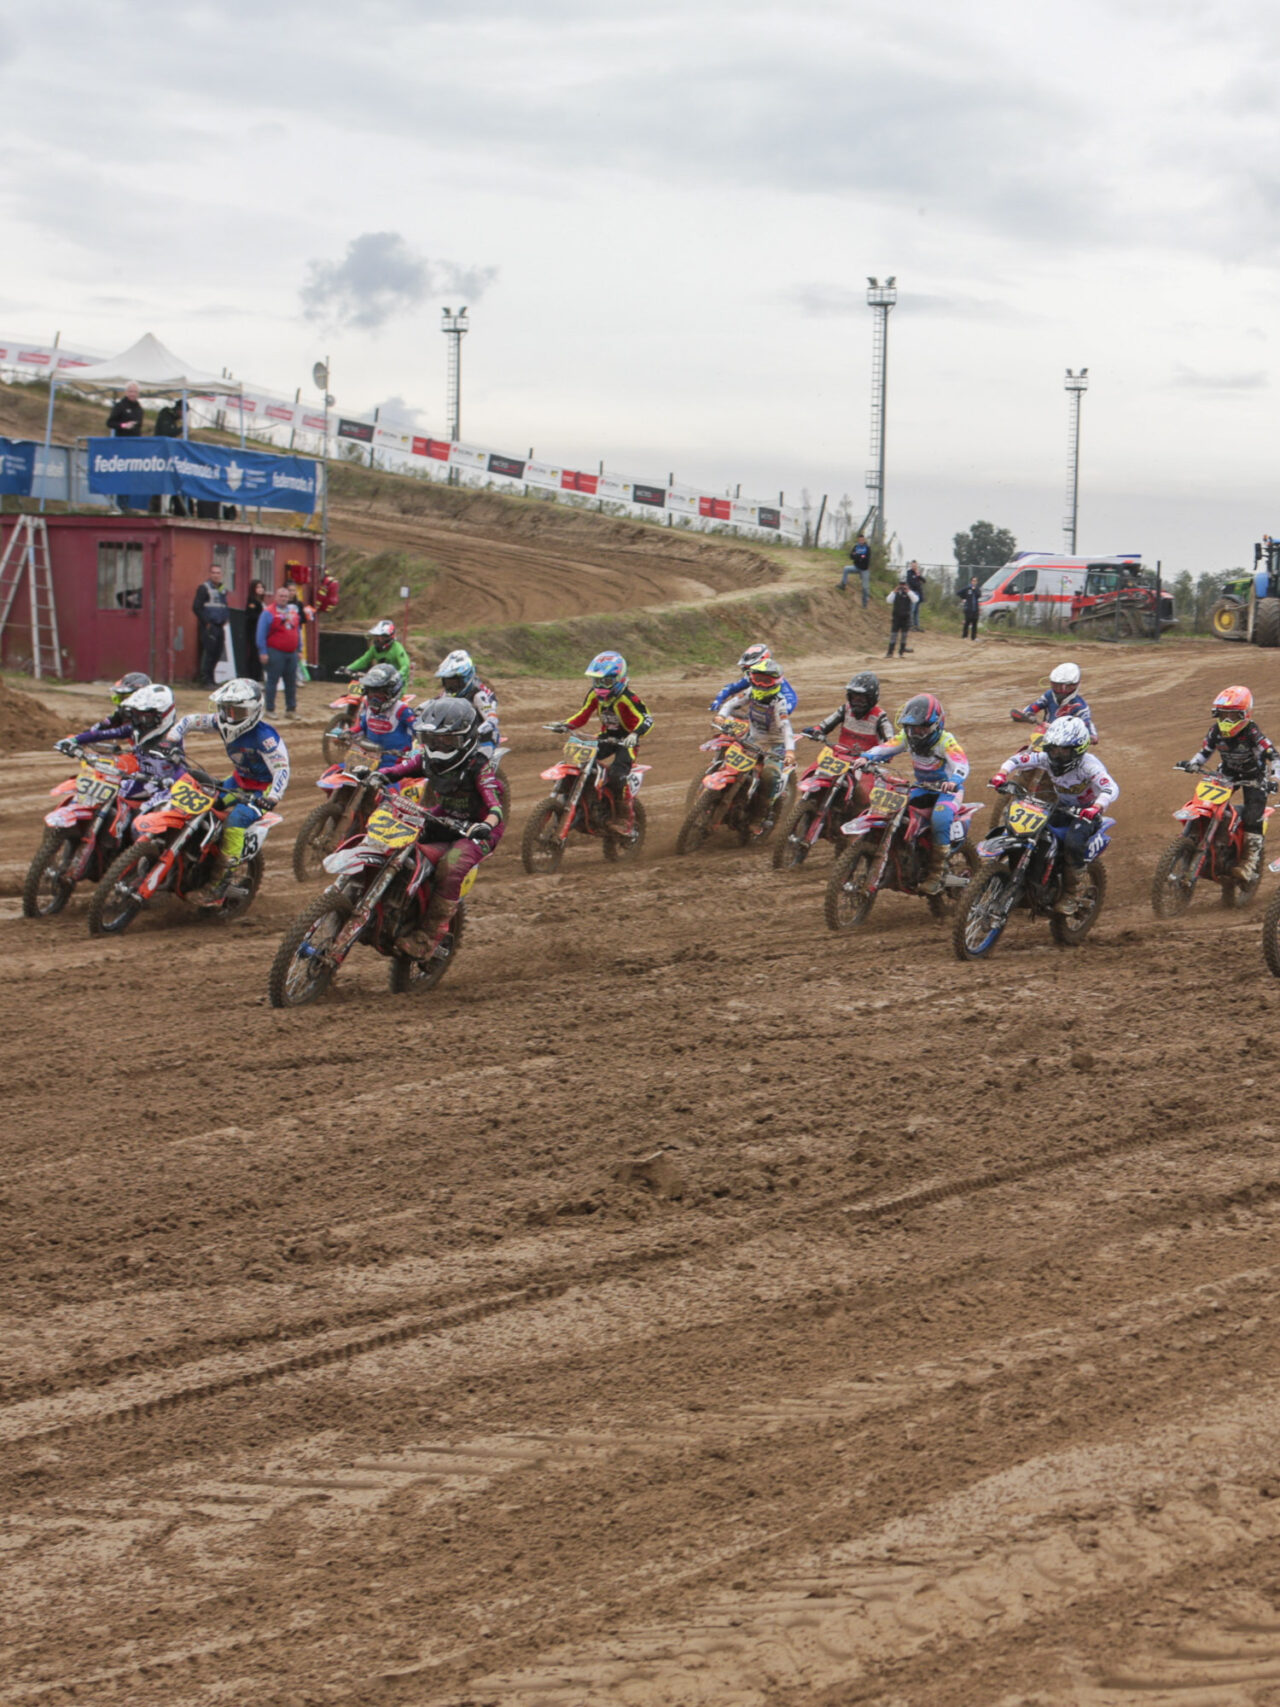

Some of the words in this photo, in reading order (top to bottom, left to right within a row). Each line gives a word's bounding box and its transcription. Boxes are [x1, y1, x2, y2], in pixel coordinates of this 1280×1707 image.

[819, 756, 846, 774] 23
[1198, 784, 1228, 801] 77
[367, 815, 417, 841] 27
[1010, 807, 1045, 830] 311
